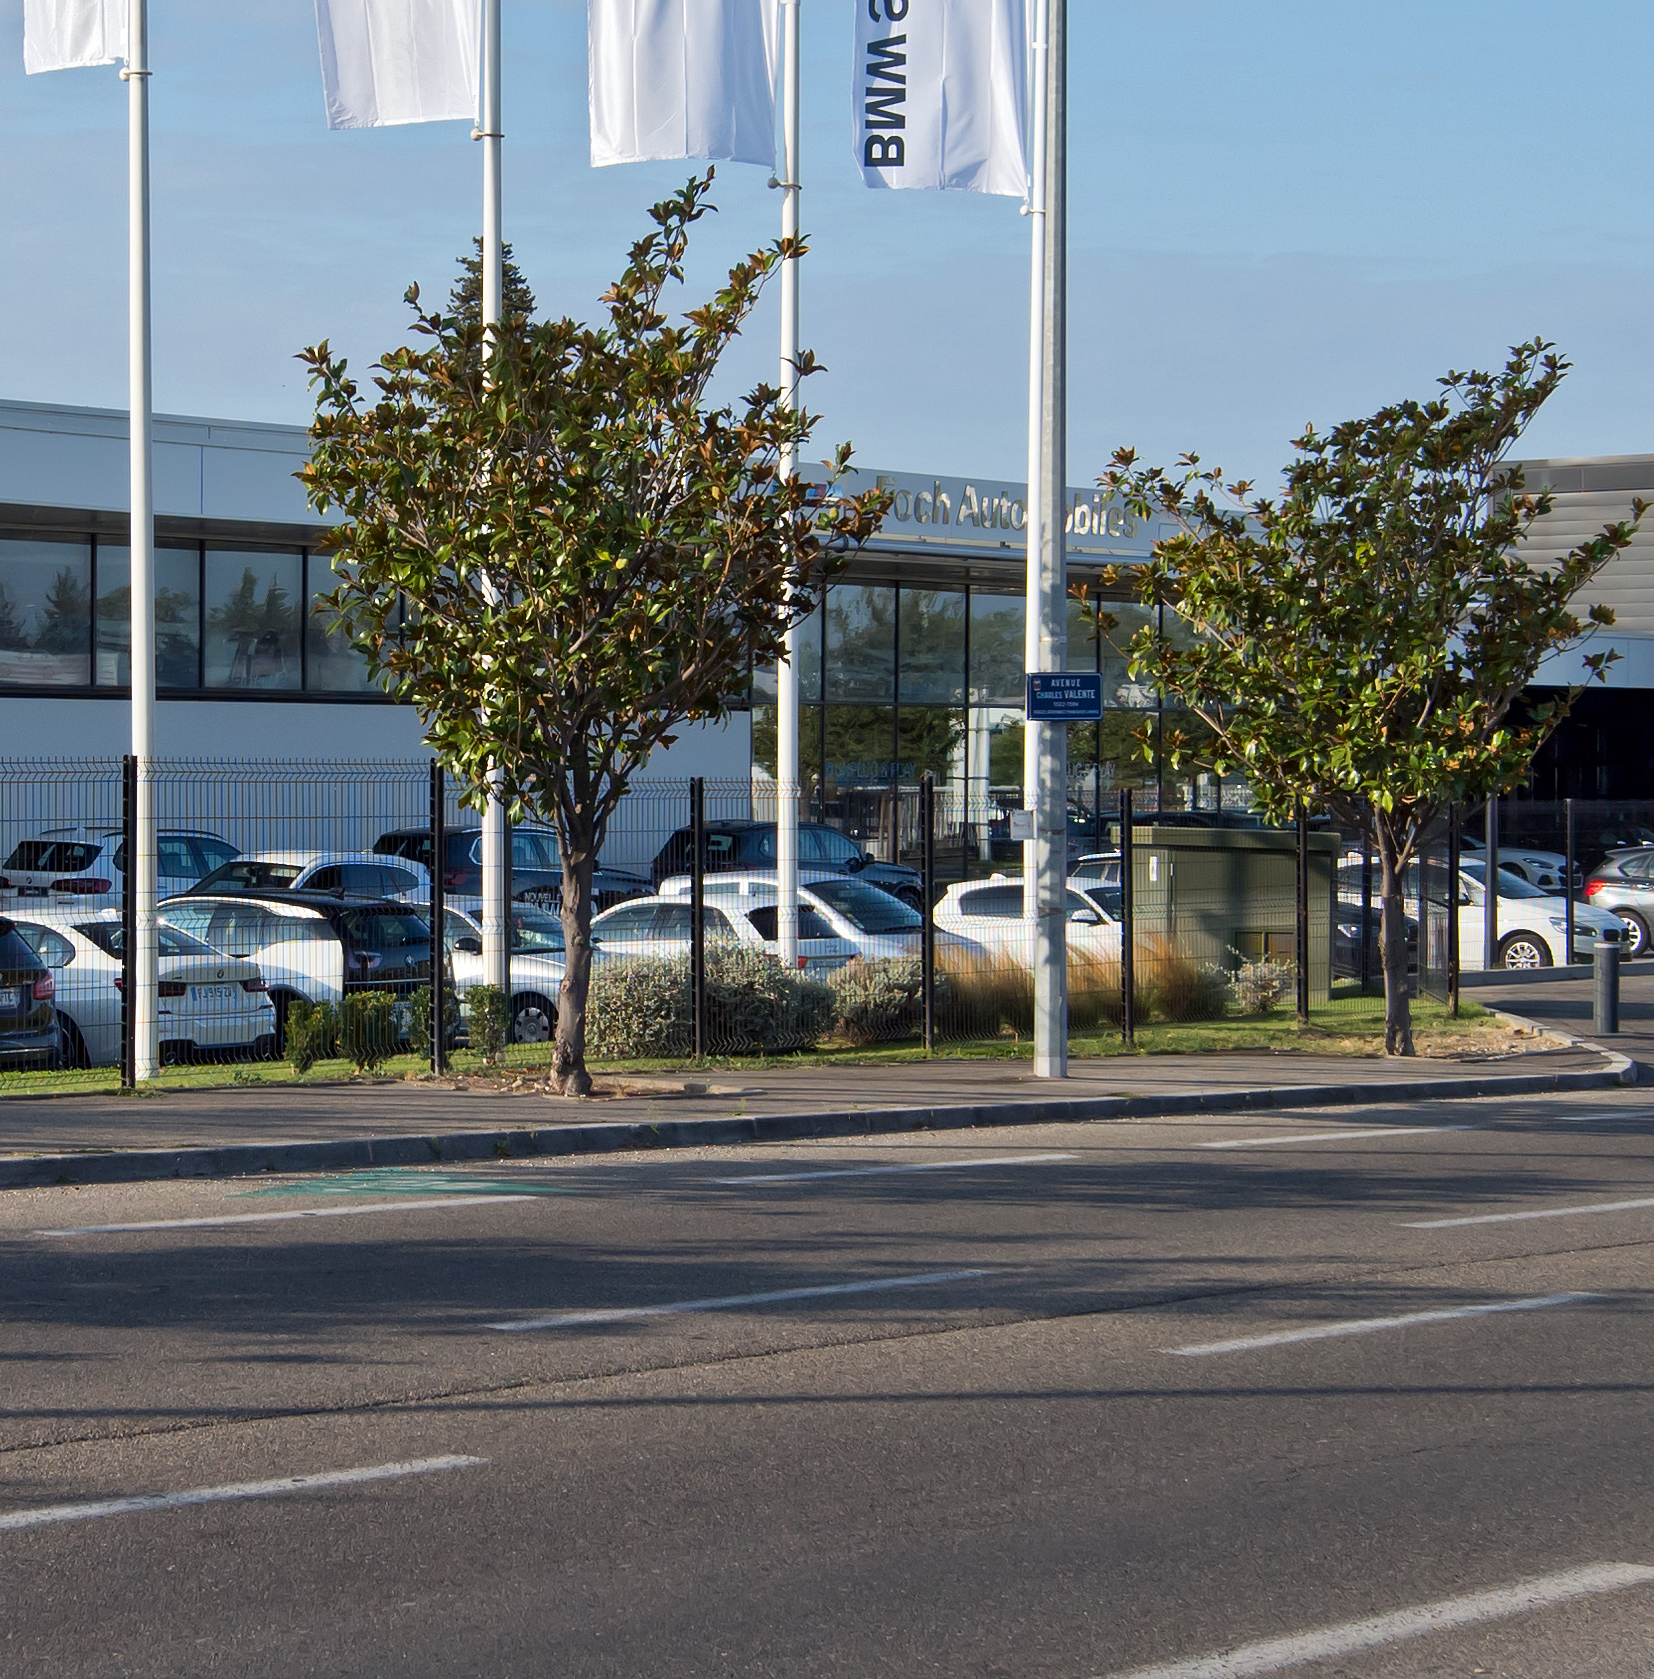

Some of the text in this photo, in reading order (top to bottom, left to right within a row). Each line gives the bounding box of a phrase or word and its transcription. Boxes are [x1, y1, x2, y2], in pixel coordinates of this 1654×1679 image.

[956, 483, 1139, 539] Autobiles
[1051, 679, 1081, 687] AVENUE
[1064, 690, 1096, 699] VALENTE
